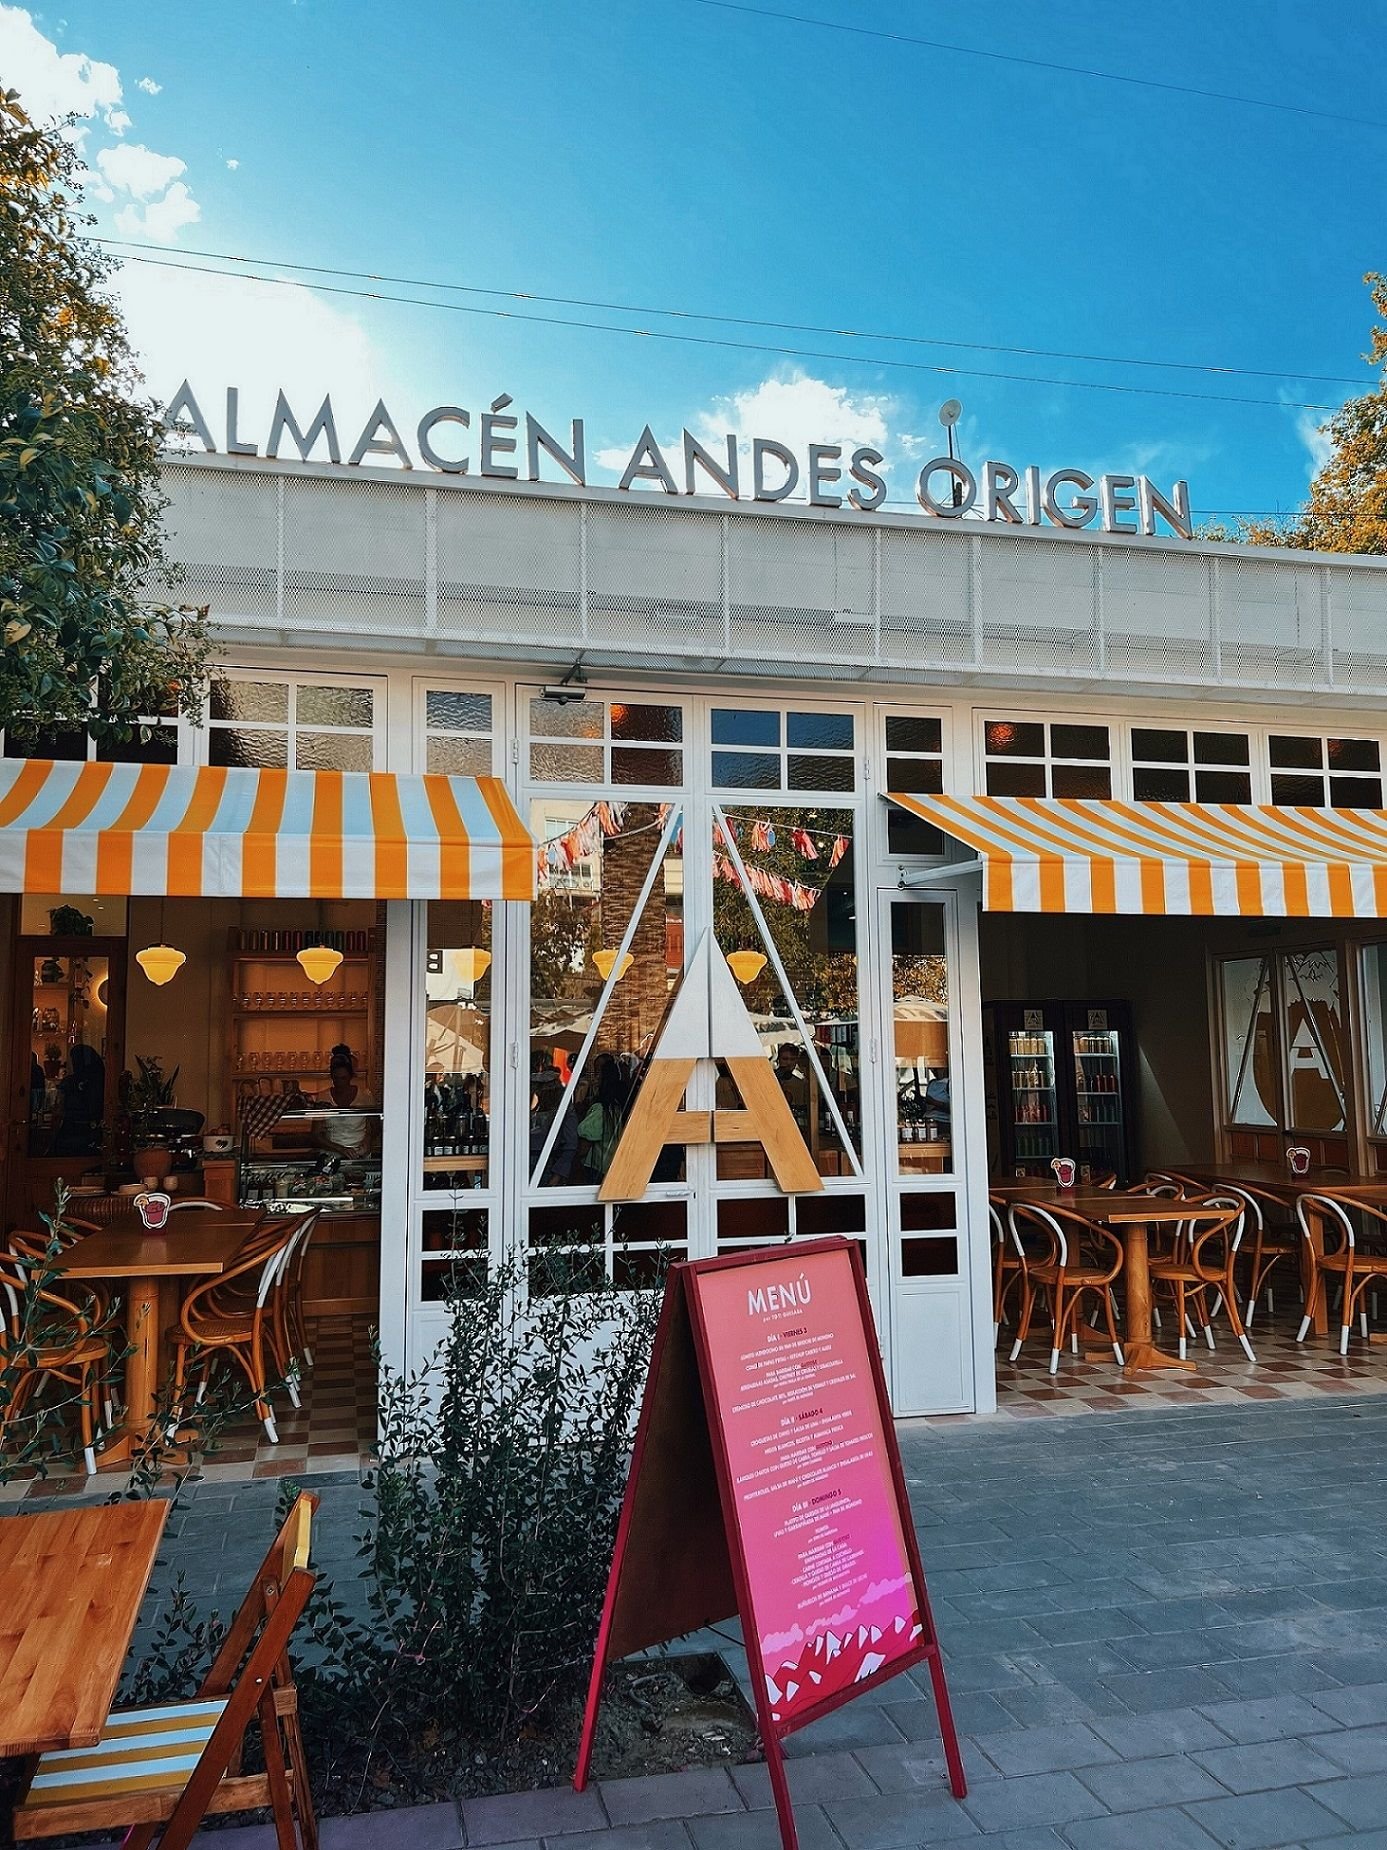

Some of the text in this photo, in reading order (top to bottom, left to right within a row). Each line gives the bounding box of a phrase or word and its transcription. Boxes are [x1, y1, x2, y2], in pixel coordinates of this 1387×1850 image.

[161, 378, 1194, 540] ALMACÉN ANDES ORIGEN
[747, 1273, 812, 1316] MENÚ
[797, 1408, 818, 1421] SÁBADO
[811, 1488, 838, 1506] DOMINGO
